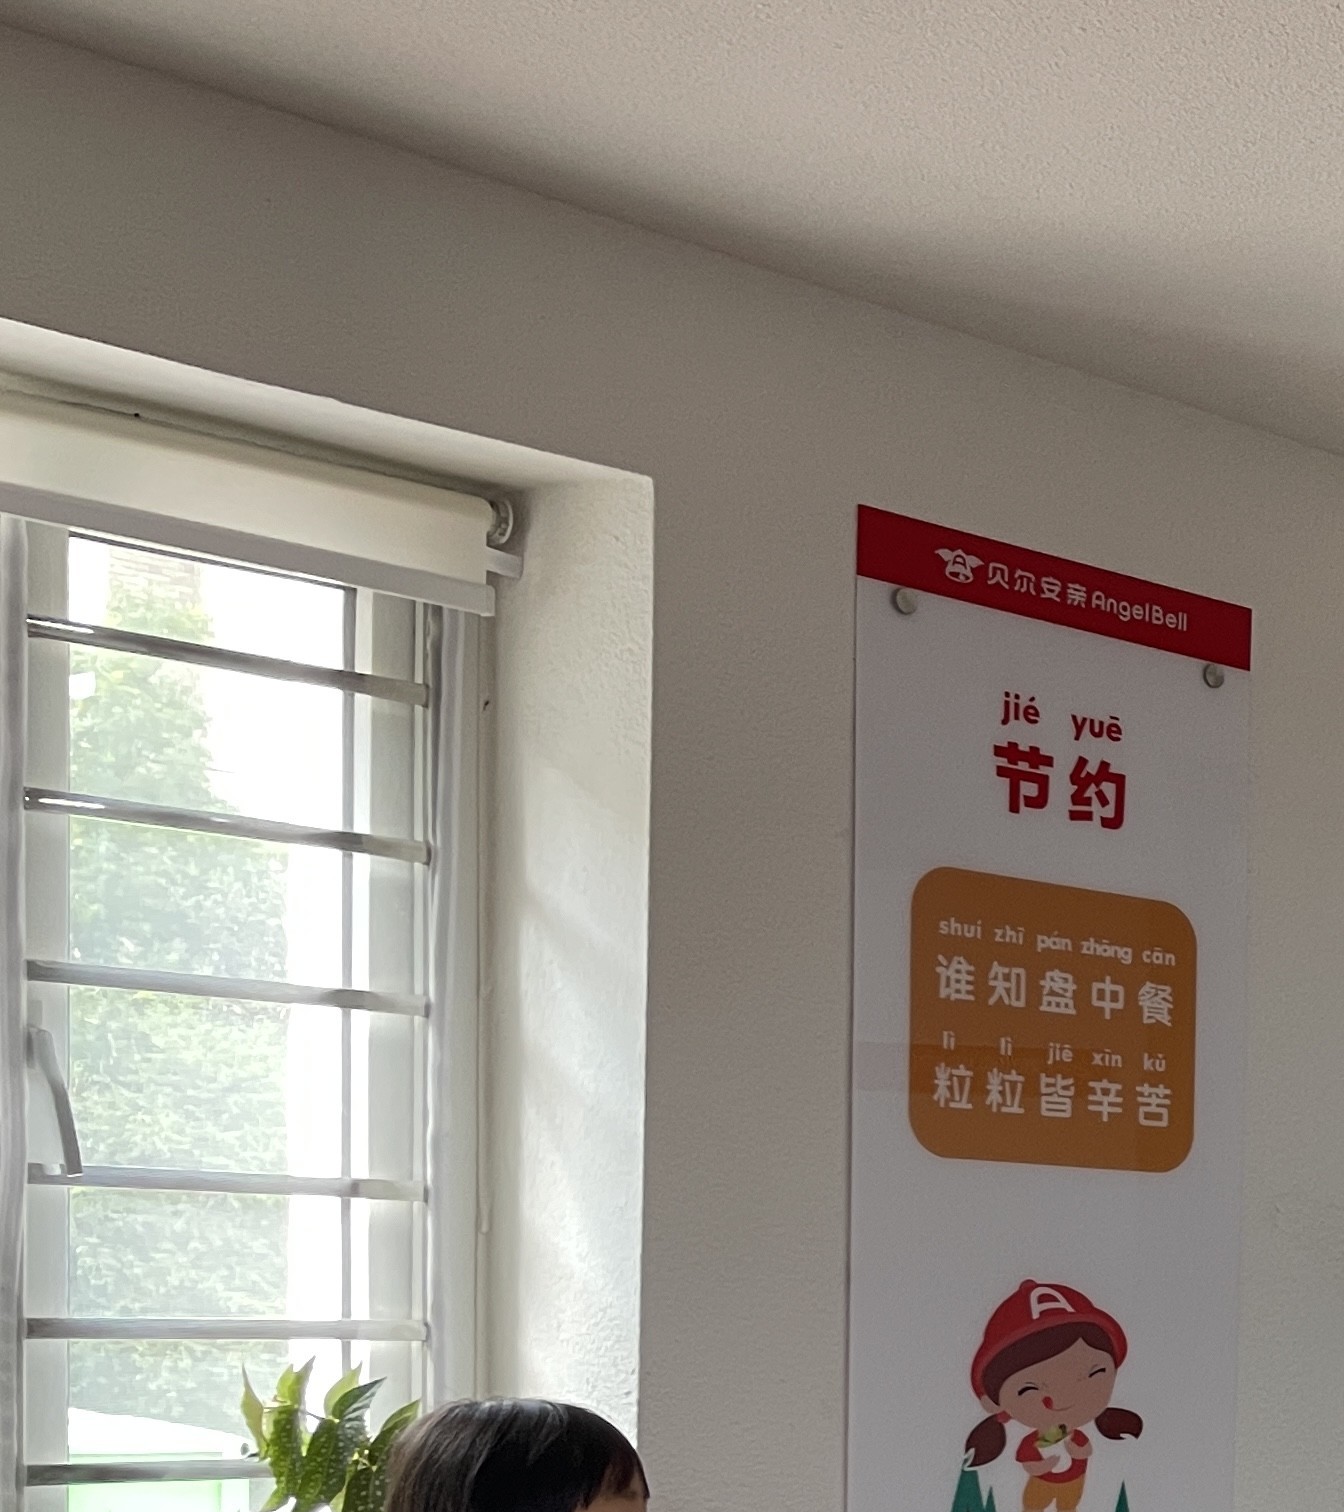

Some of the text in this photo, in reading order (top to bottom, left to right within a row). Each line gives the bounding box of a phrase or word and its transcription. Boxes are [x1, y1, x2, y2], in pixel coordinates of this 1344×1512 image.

[987, 562, 1187, 631] 贝尔安亲 AngelBell
[1001, 691, 1123, 741] jié yuē
[993, 741, 1126, 830] 节约
[1036, 930, 1072, 952] pán
[1142, 947, 1176, 966] cān
[935, 954, 1174, 1027] 谁知盘中餐
[1091, 1049, 1122, 1068] xīn
[933, 1061, 1172, 1128] 粒粒皆辛苦
